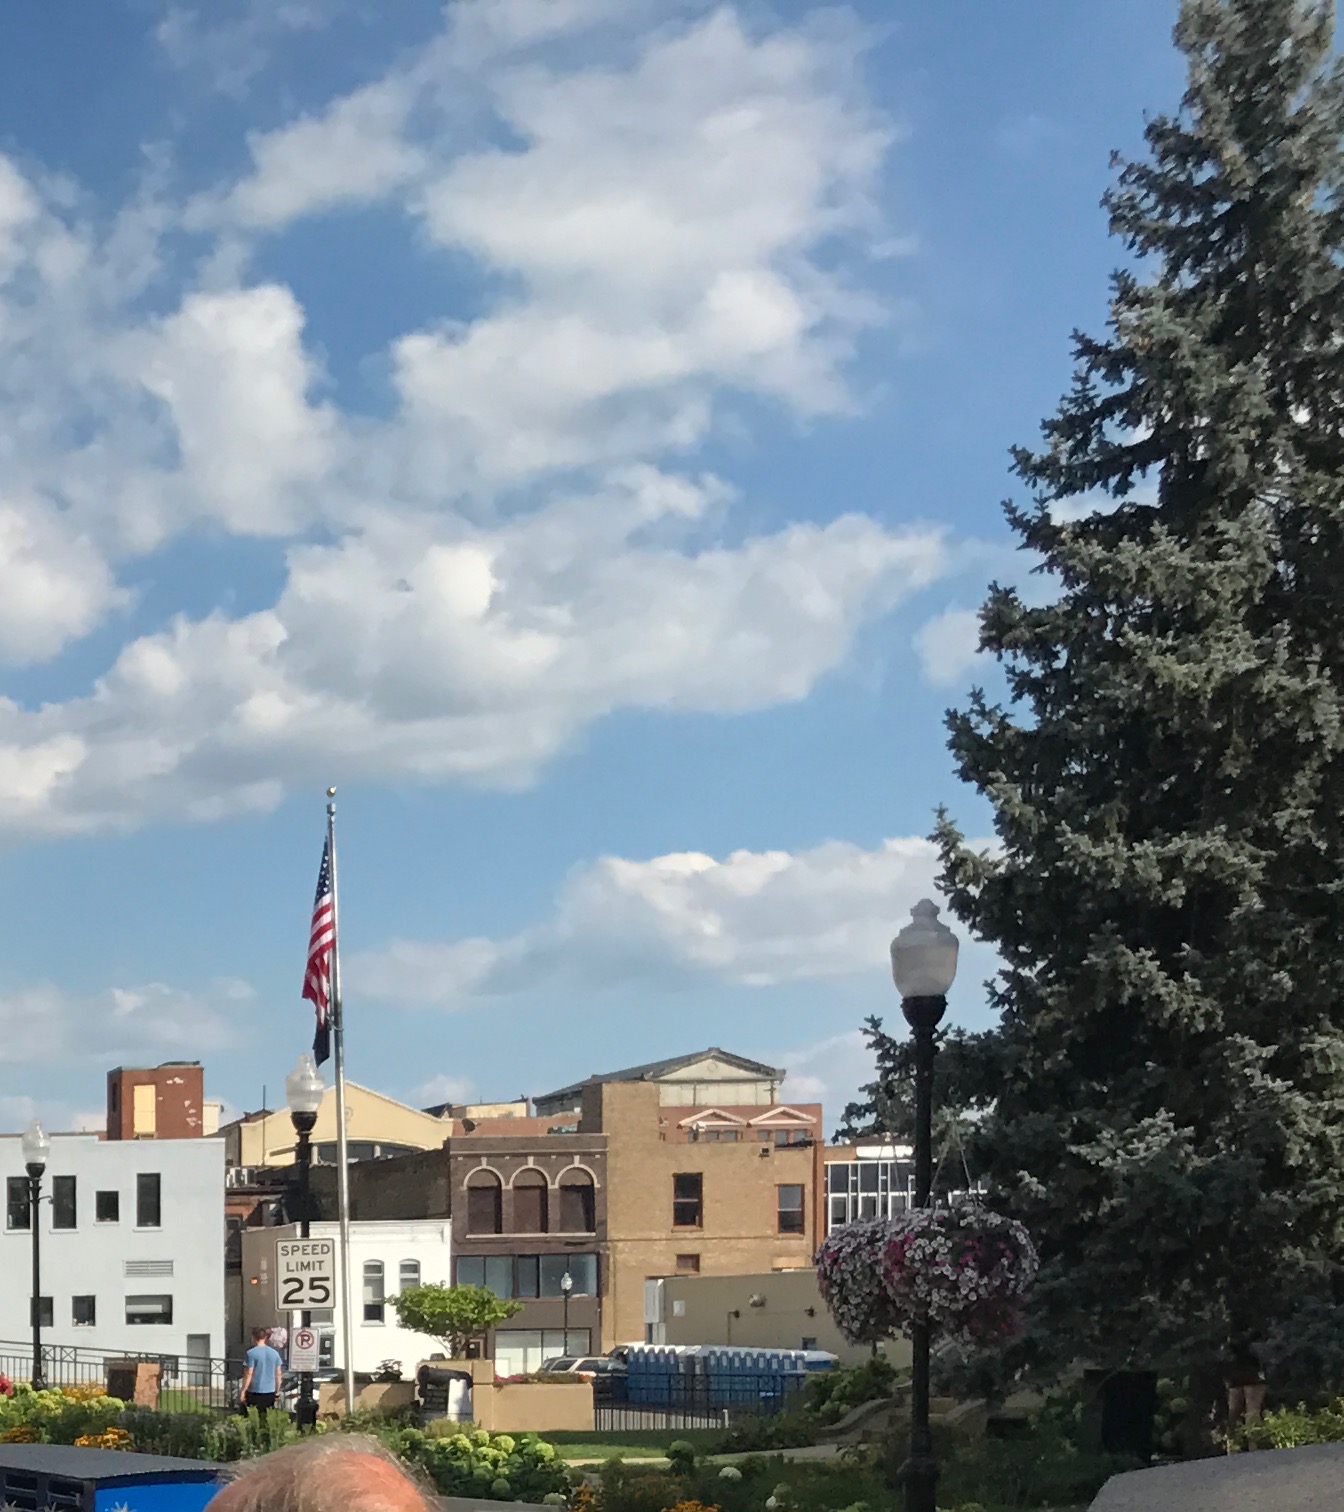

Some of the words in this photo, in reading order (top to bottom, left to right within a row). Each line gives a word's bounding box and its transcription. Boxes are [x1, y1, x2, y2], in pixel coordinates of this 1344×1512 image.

[280, 1243, 331, 1257] SPEED
[286, 1260, 325, 1273] LIMIT
[282, 1276, 331, 1305] 25
